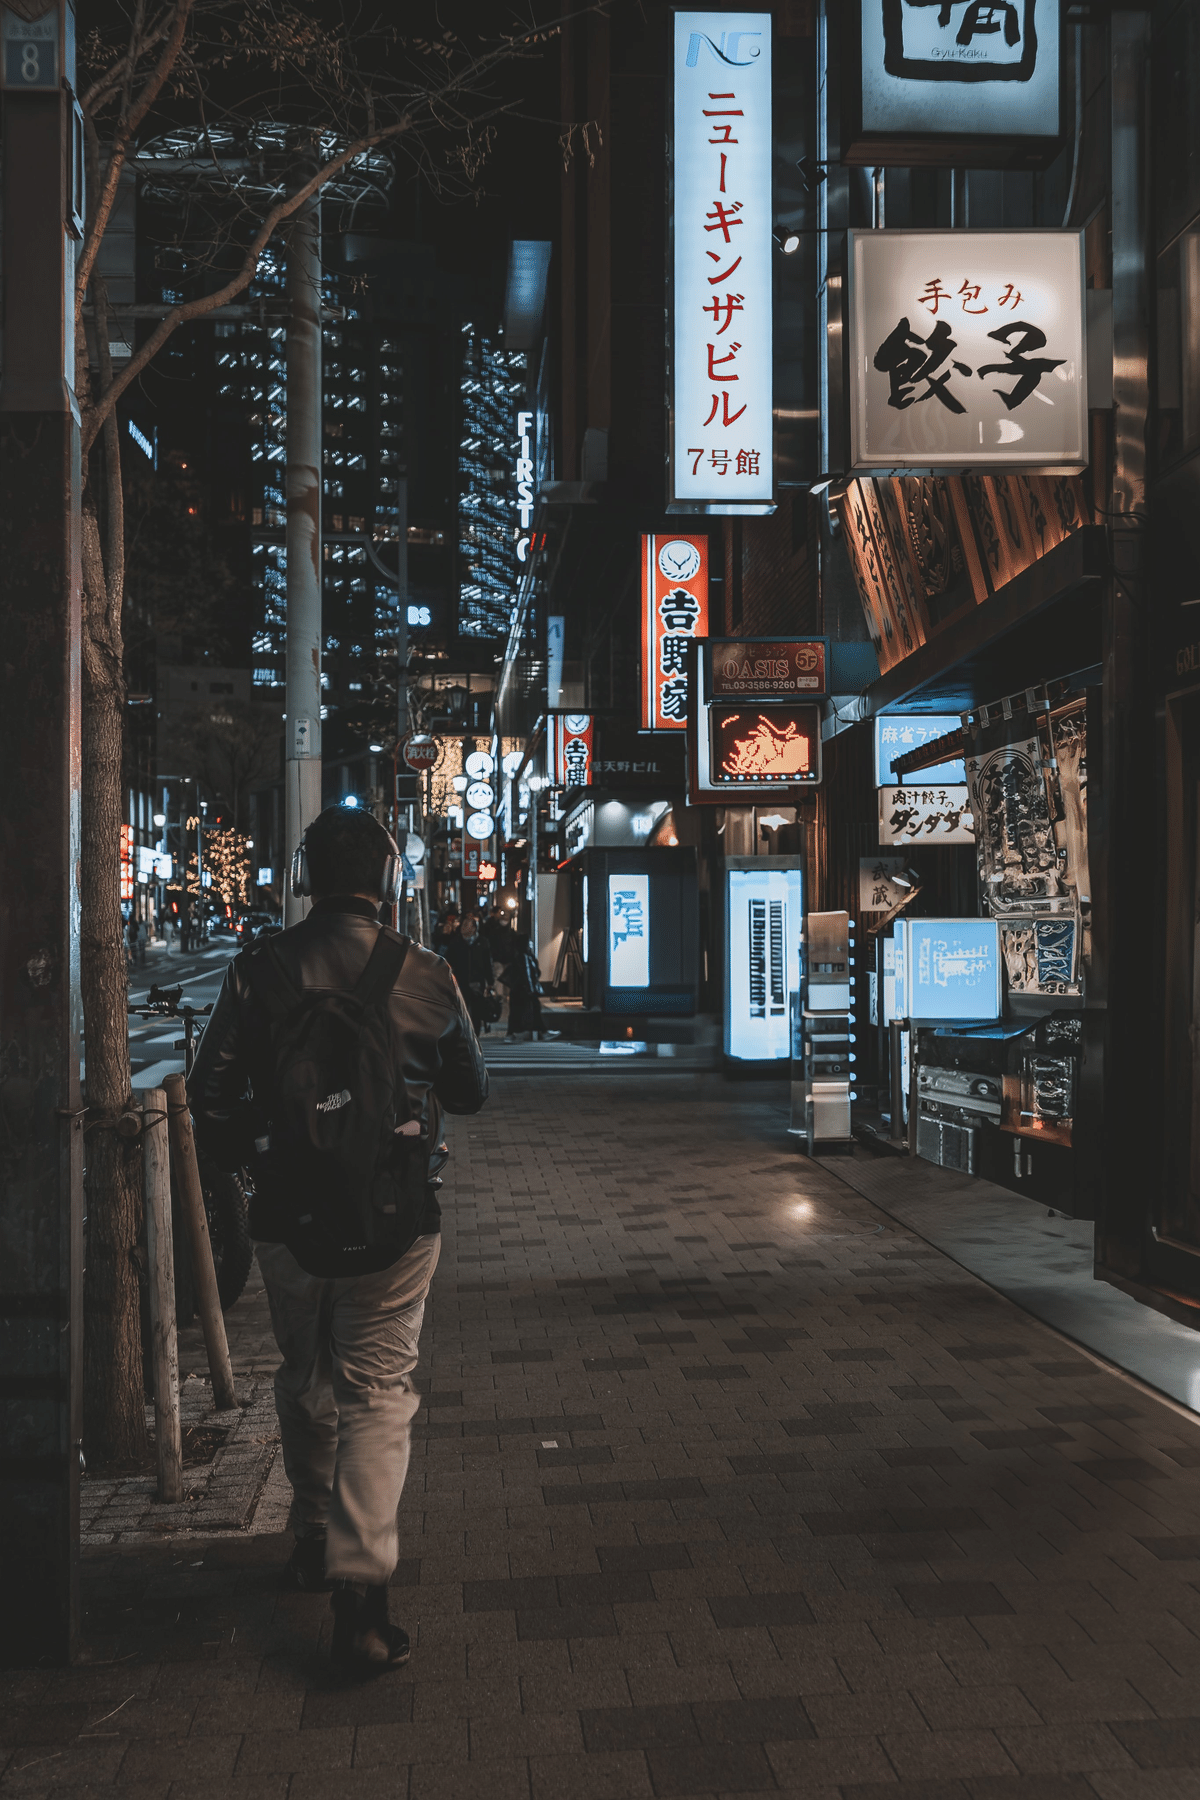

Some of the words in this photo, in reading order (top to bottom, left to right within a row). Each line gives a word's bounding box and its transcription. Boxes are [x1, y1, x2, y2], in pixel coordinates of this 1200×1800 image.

[21, 41, 40, 83] 8
[702, 91, 747, 429] ニューギンザビル
[917, 278, 1025, 315] 手包み
[873, 317, 1067, 415] 餃子
[516, 411, 535, 529] FIRST
[687, 447, 761, 477] 7号館
[722, 659, 789, 679] OASIS
[797, 653, 816, 668] 5F
[407, 745, 435, 760] 消火栓
[892, 789, 955, 808] 肉汁餃子の
[871, 861, 892, 907] 武蔵
[316, 1096, 342, 1110] NORTH
[342, 1244, 367, 1252] VAULT
